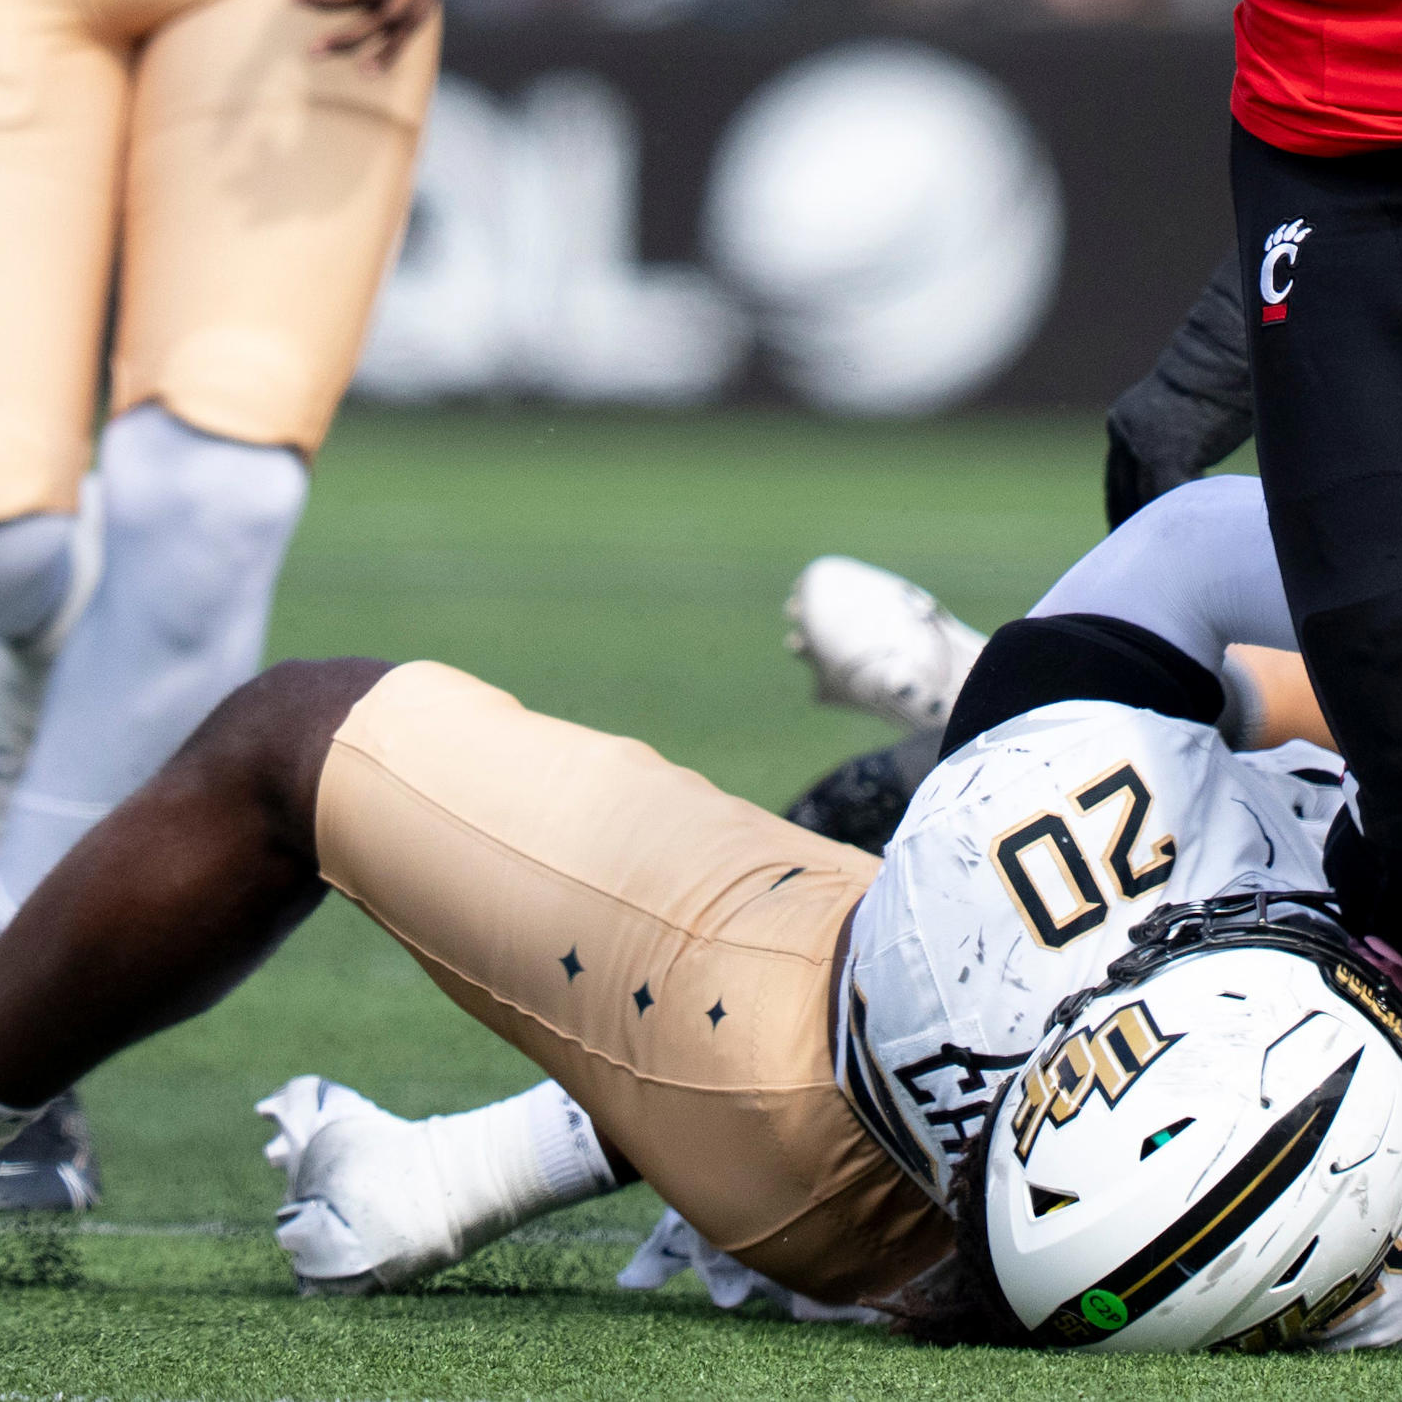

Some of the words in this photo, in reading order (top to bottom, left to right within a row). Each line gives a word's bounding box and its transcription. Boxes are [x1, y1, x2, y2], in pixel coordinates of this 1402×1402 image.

[989, 759, 1178, 953] 20
[1009, 1000, 1190, 1167] UCF
[1088, 1294, 1122, 1324] C2P
